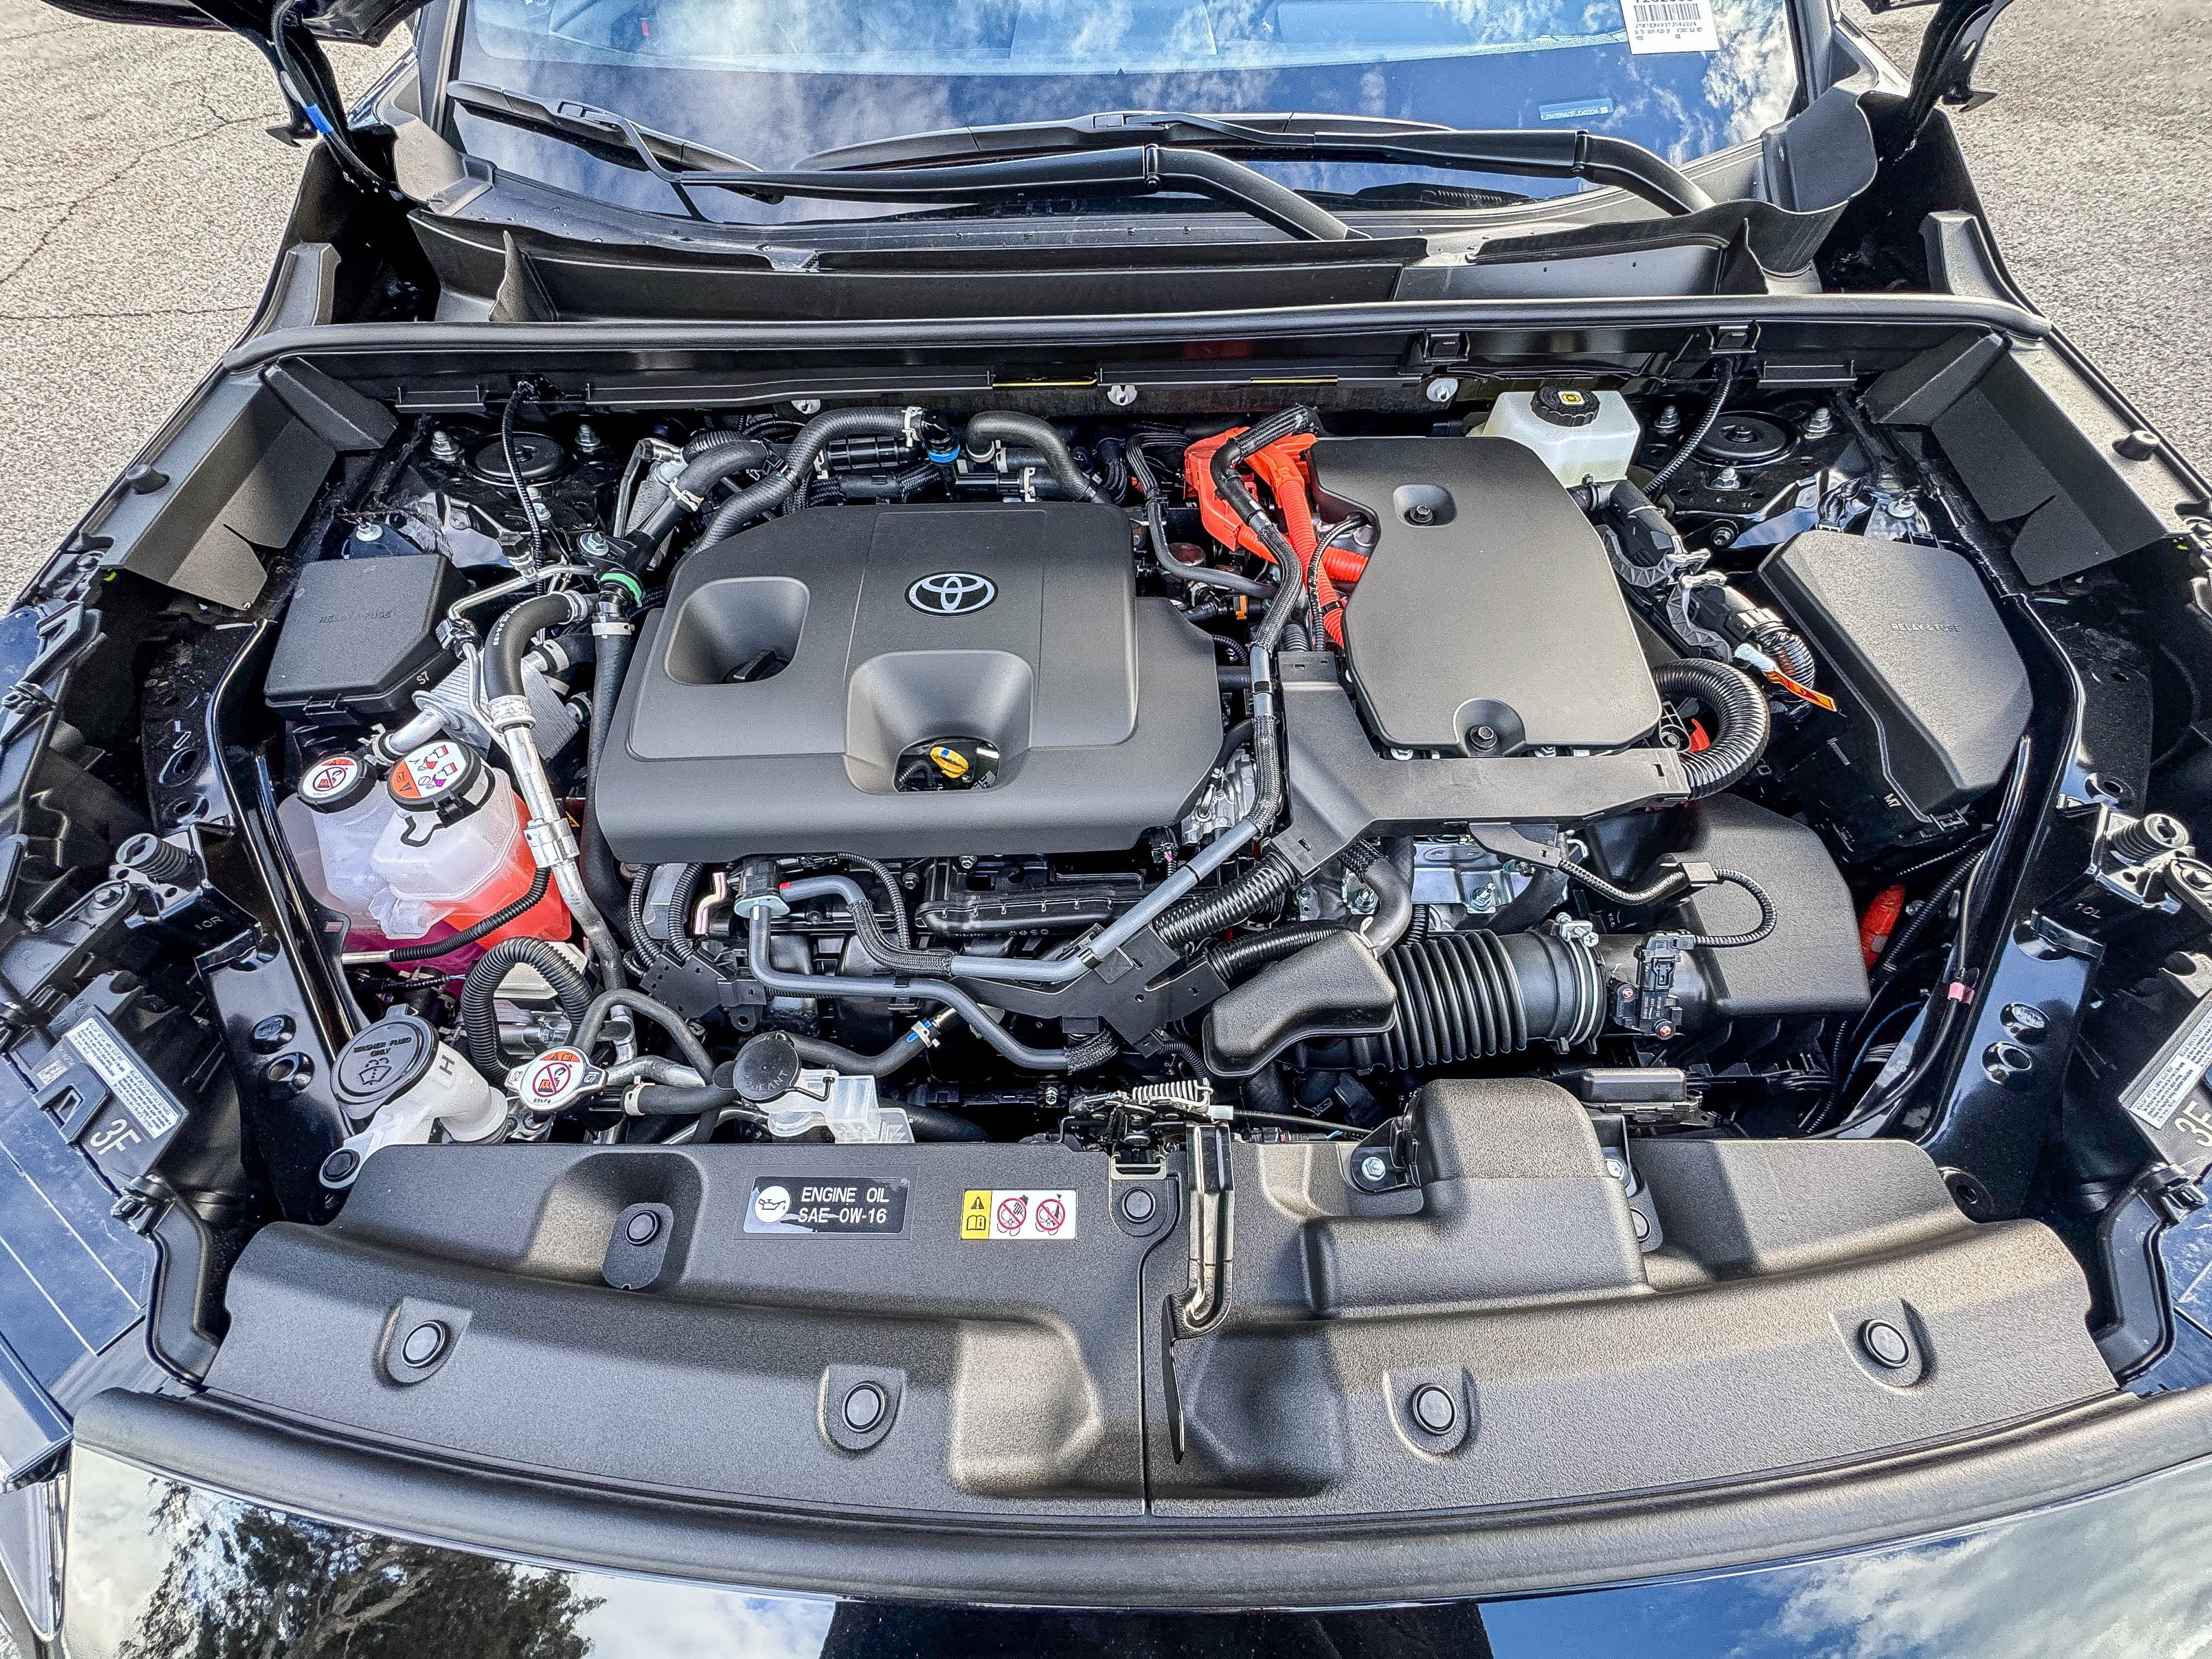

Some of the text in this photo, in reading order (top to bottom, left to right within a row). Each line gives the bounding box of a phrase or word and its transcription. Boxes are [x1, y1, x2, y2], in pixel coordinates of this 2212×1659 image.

[1891, 622, 1923, 631] RELAY
[1934, 624, 1962, 632] FUSE
[416, 670, 430, 685] S7
[1884, 793, 1902, 808] M7
[370, 1047, 392, 1057] ONLY
[2174, 1100, 2212, 1147] 3F
[90, 1119, 142, 1155] 3F
[801, 1187, 890, 1203] ENGINE OIL
[797, 1207, 888, 1224] SAE 0W-16
